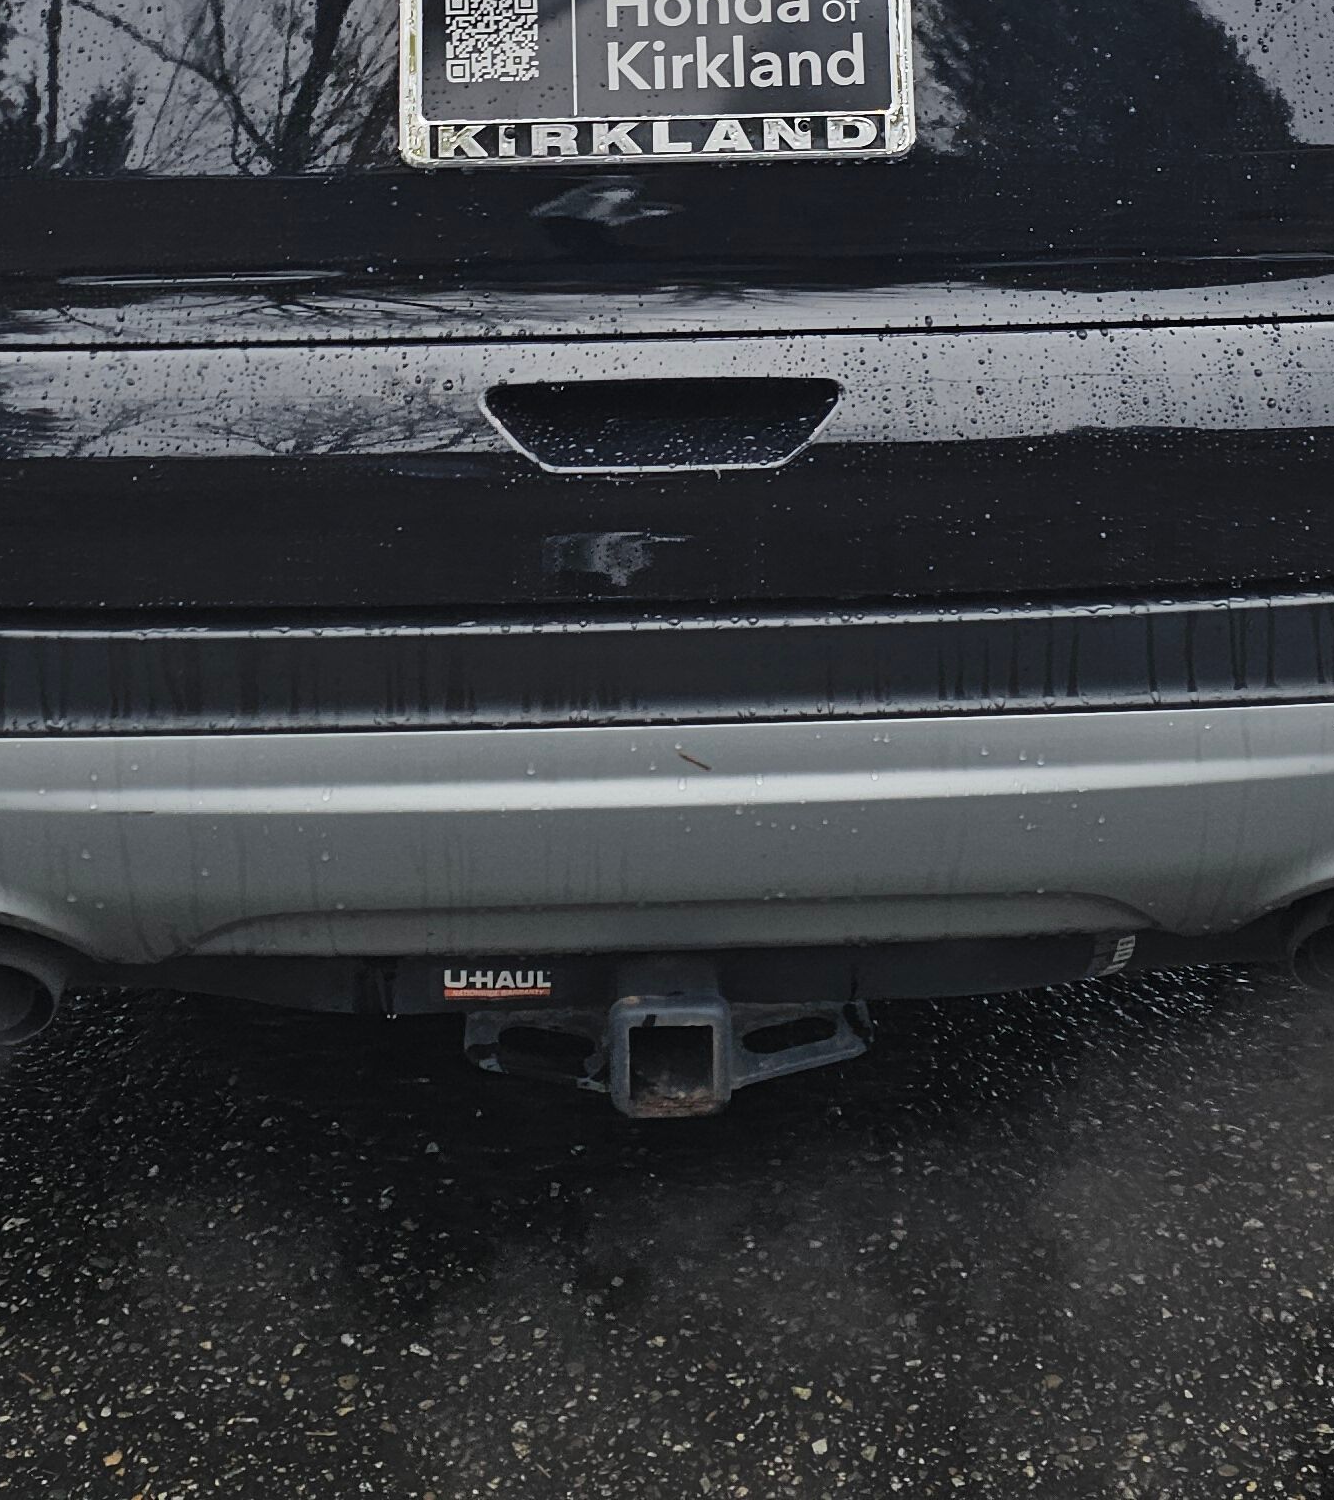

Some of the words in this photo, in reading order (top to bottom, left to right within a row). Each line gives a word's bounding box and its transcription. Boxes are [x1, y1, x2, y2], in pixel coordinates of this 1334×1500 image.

[605, 33, 865, 90] Kirkland
[437, 117, 878, 158] KIRKLAND
[443, 969, 552, 989] U-HAUL
